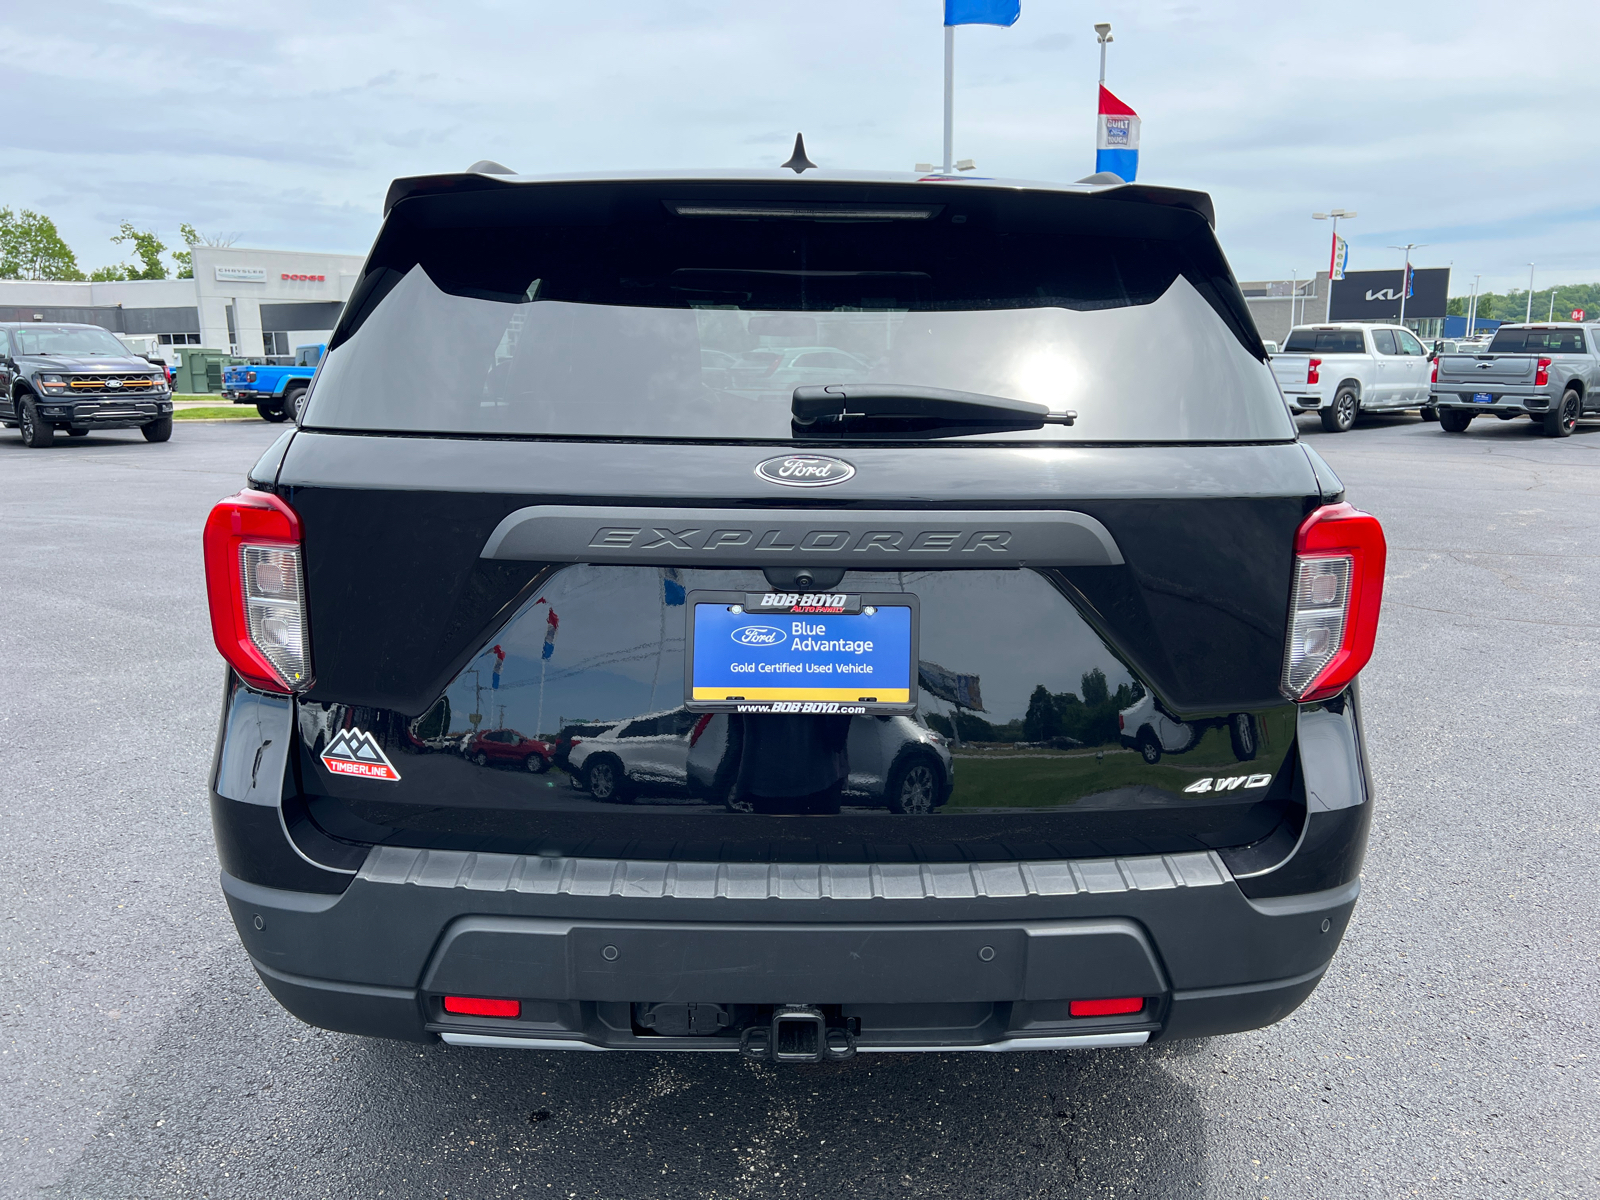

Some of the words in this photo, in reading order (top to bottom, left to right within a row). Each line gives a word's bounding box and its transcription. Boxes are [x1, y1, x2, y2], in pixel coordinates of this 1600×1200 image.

[1107, 119, 1129, 128] BUILT
[1335, 244, 1344, 277] Jeep
[281, 273, 326, 282] DODGE
[1572, 311, 1584, 321] 84
[778, 459, 832, 477] Ford
[588, 527, 1013, 553] EXPLORER
[790, 605, 815, 613] AUTO
[741, 627, 777, 643] Ford
[792, 621, 826, 636] Blue
[791, 637, 874, 654] Advantage
[730, 662, 755, 673] Gold
[758, 663, 802, 673] Certified
[805, 663, 833, 673] Used
[836, 663, 873, 673] Vehicle
[330, 761, 388, 777] TIMBERLINE
[1184, 774, 1272, 793] 4WD
